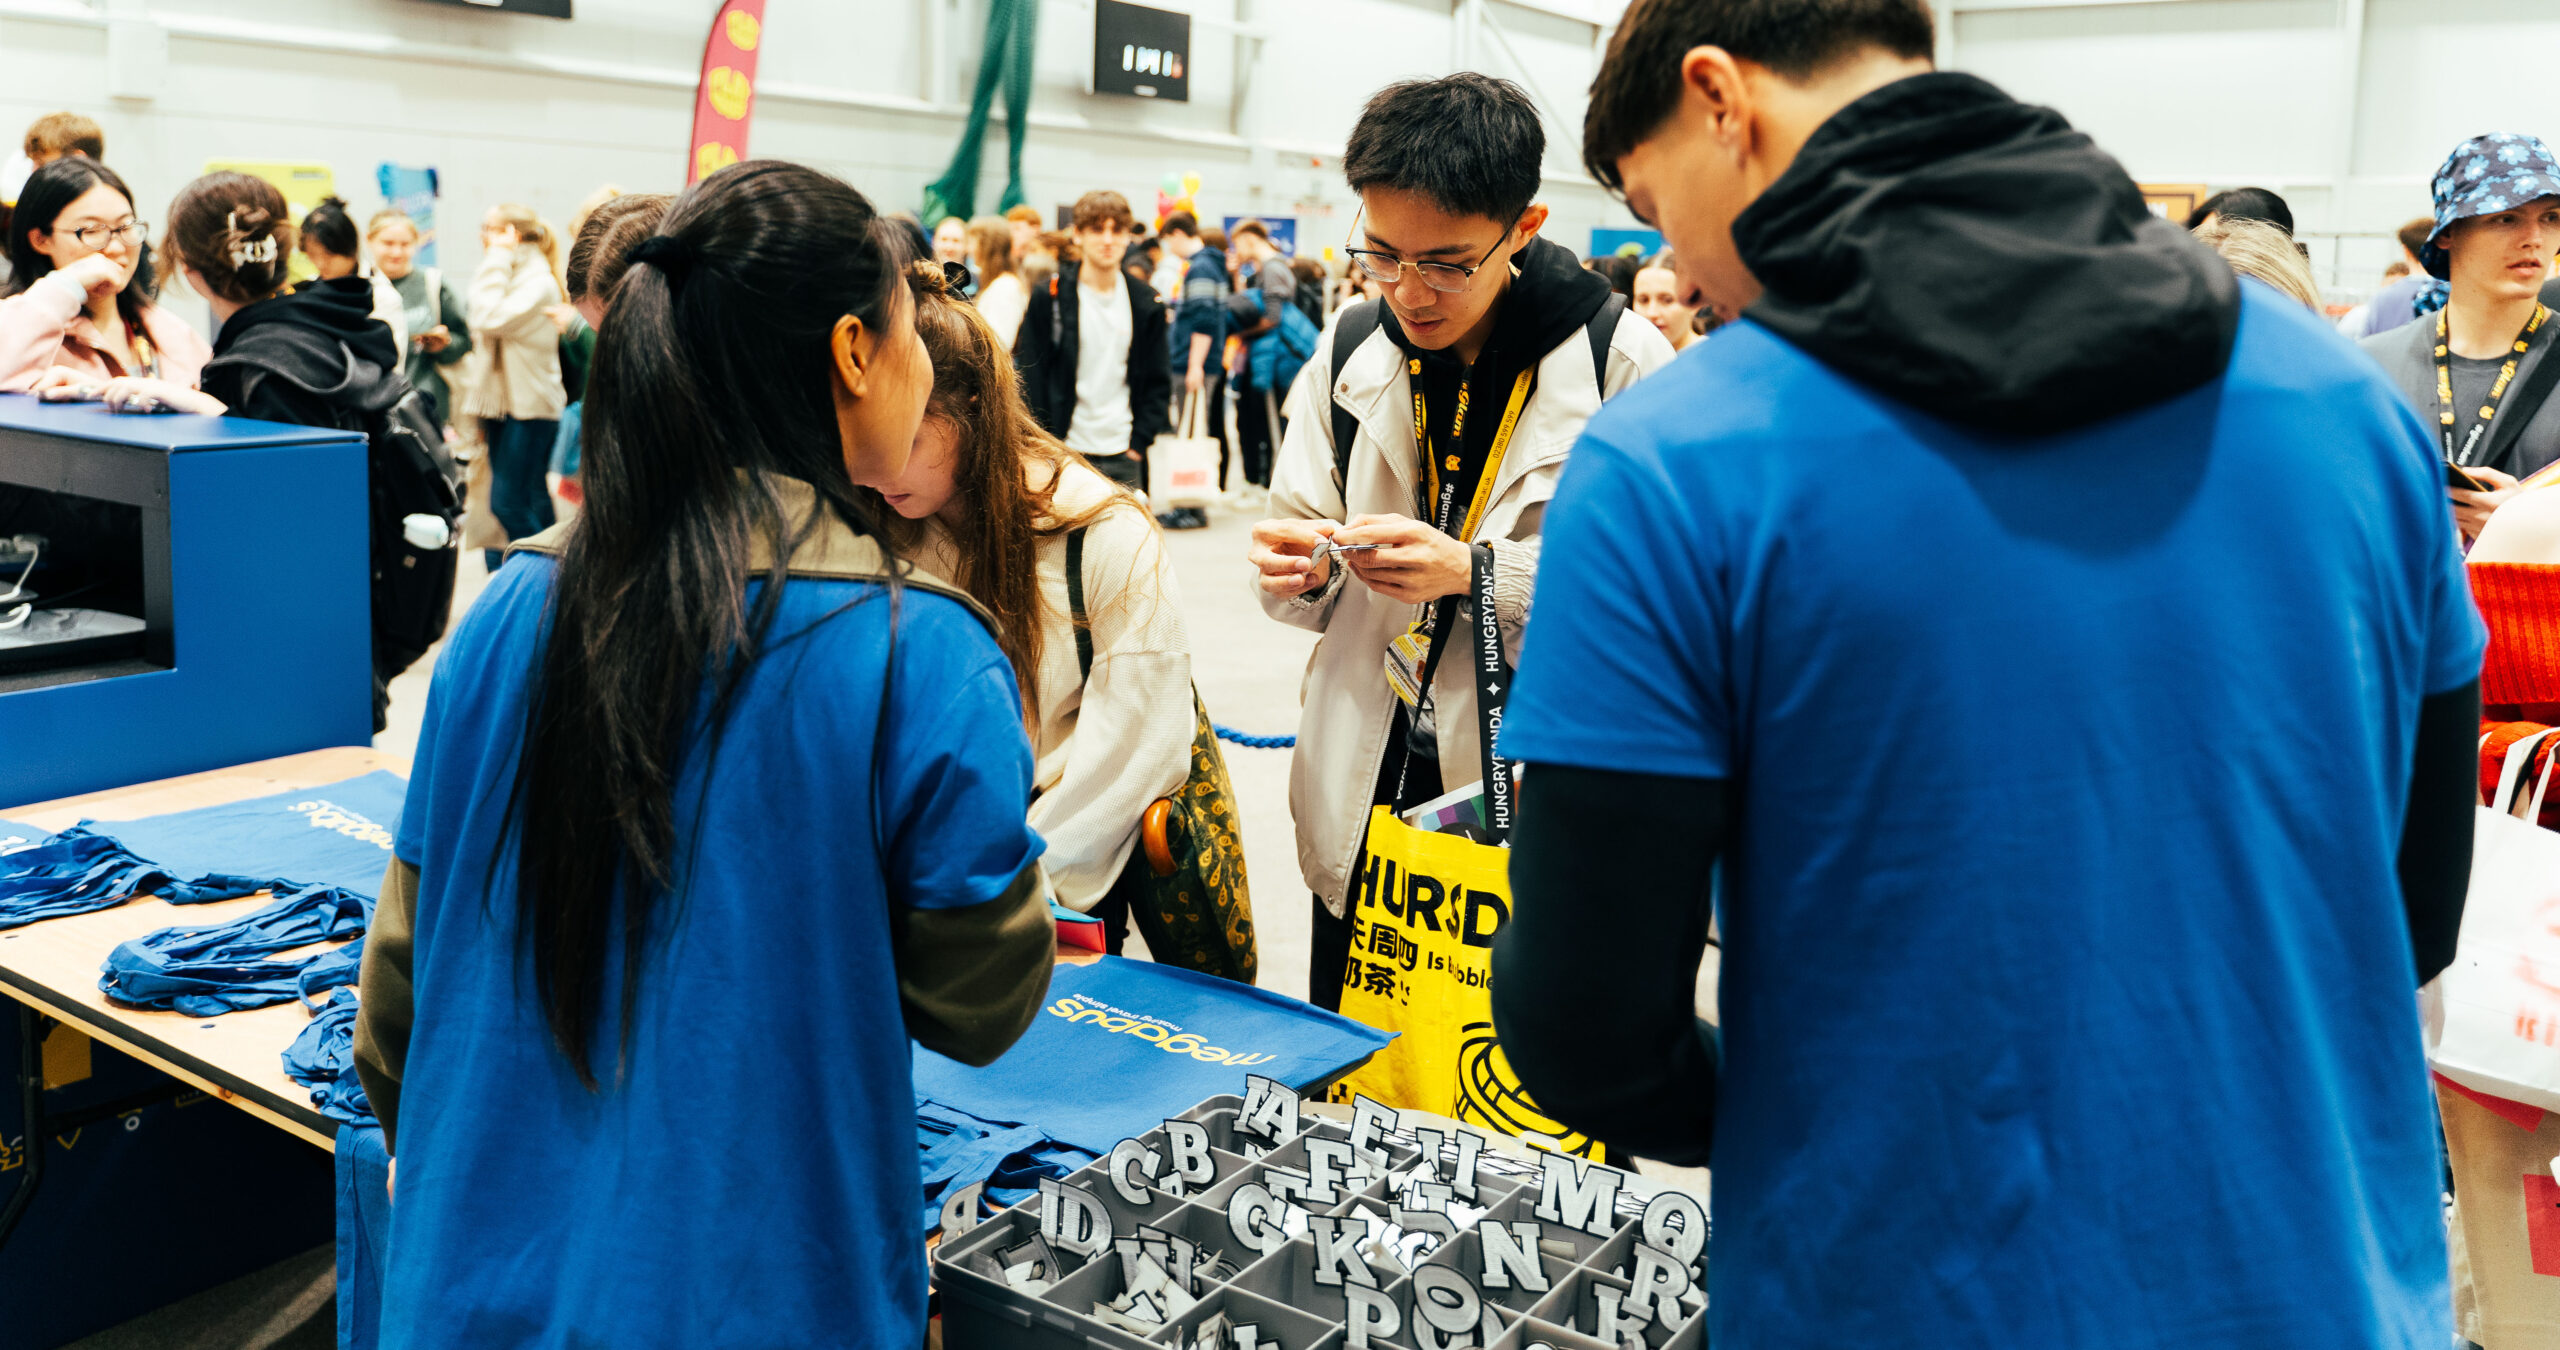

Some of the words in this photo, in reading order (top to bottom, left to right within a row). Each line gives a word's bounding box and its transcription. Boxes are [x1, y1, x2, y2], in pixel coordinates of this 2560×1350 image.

[1464, 476, 1492, 542] enthub@soton.ac.uk
[1481, 556, 1500, 672] HUNGRYPAN
[1361, 853, 1511, 948] HURSD
[1427, 951, 1444, 970] Is
[1047, 998, 1278, 1066] megabus
[1072, 993, 1109, 1010] simple
[1108, 1006, 1140, 1020] travel
[1139, 1014, 1183, 1032] making
[1246, 1079, 1300, 1146] A
[1107, 1137, 1163, 1206] C
[1163, 1118, 1217, 1185] B
[1304, 1135, 1356, 1206] F
[1533, 1151, 1625, 1241] M
[1306, 1213, 1379, 1288] K
[1477, 1218, 1551, 1293] N
